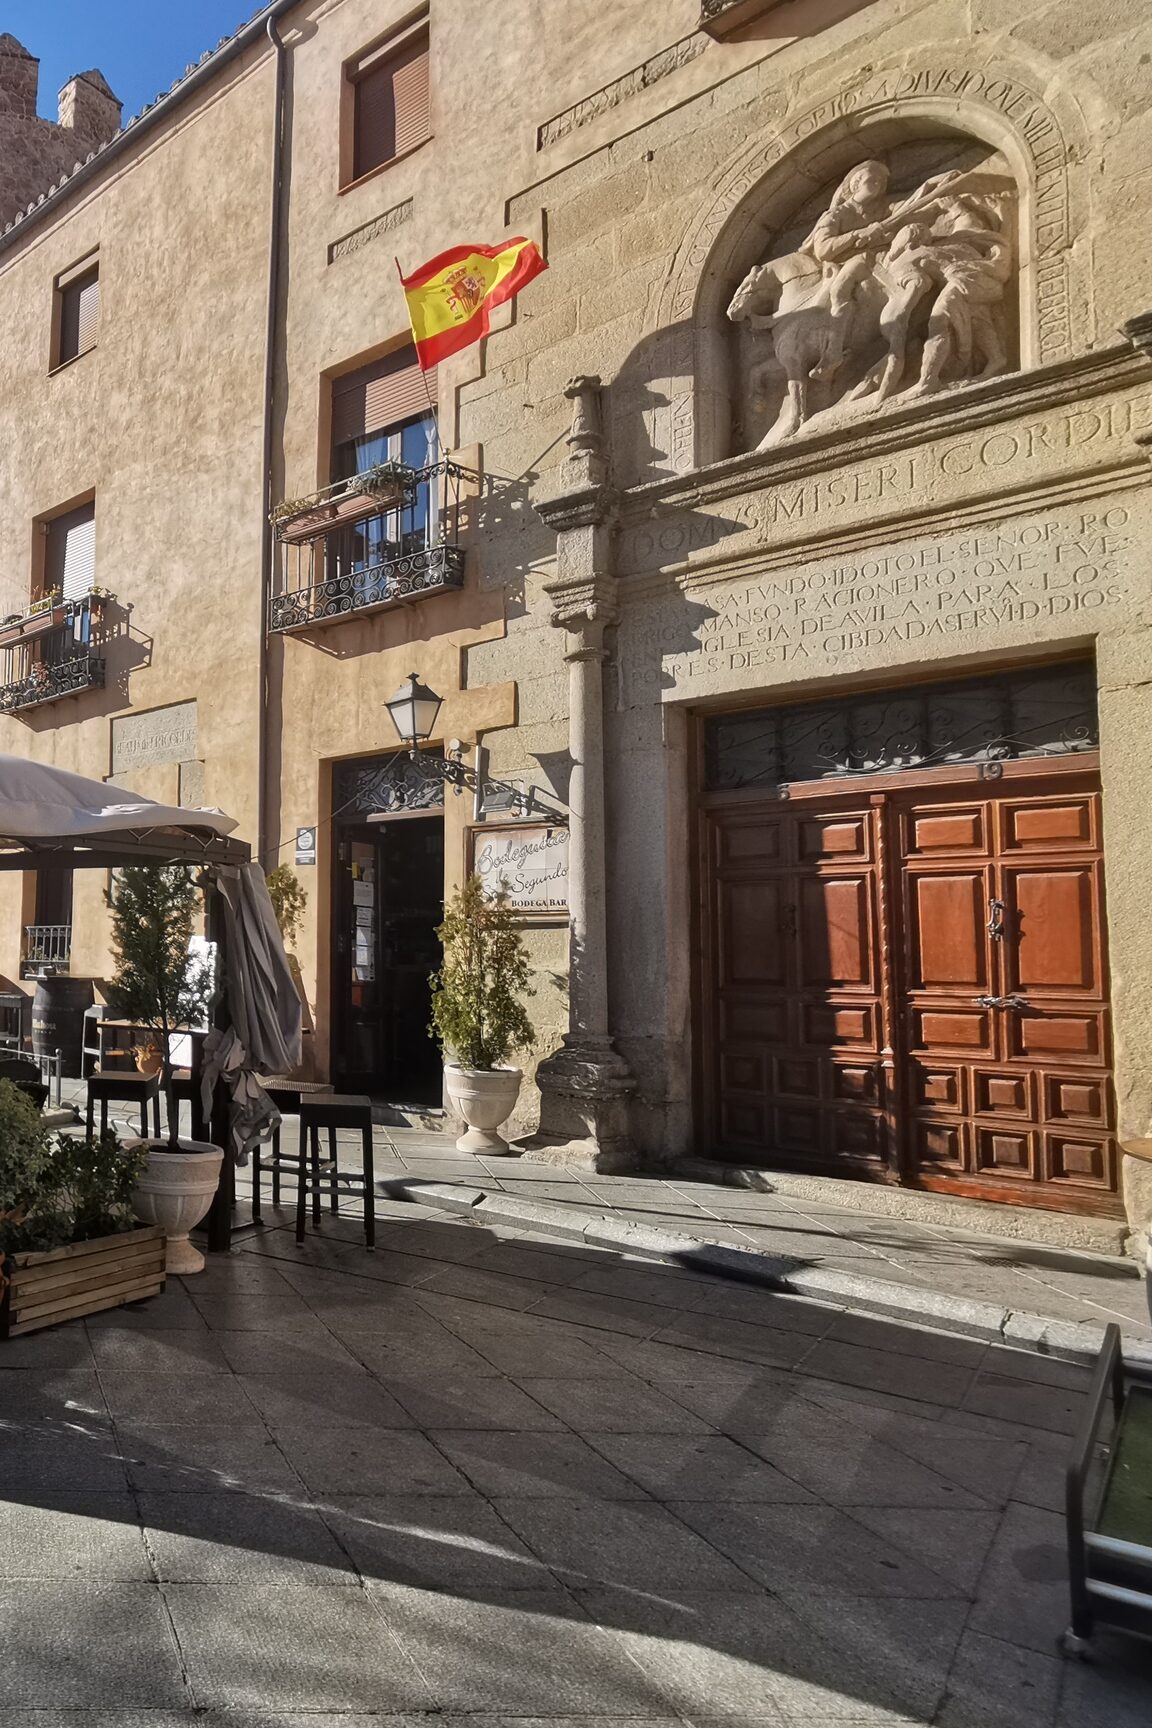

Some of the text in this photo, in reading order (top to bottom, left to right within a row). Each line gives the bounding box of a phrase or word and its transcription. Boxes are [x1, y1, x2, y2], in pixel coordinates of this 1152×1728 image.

[631, 502, 760, 563] DOMVS
[1079, 507, 1130, 535] RO
[511, 861, 569, 895] Segundo
[549, 898, 567, 907] BAR
